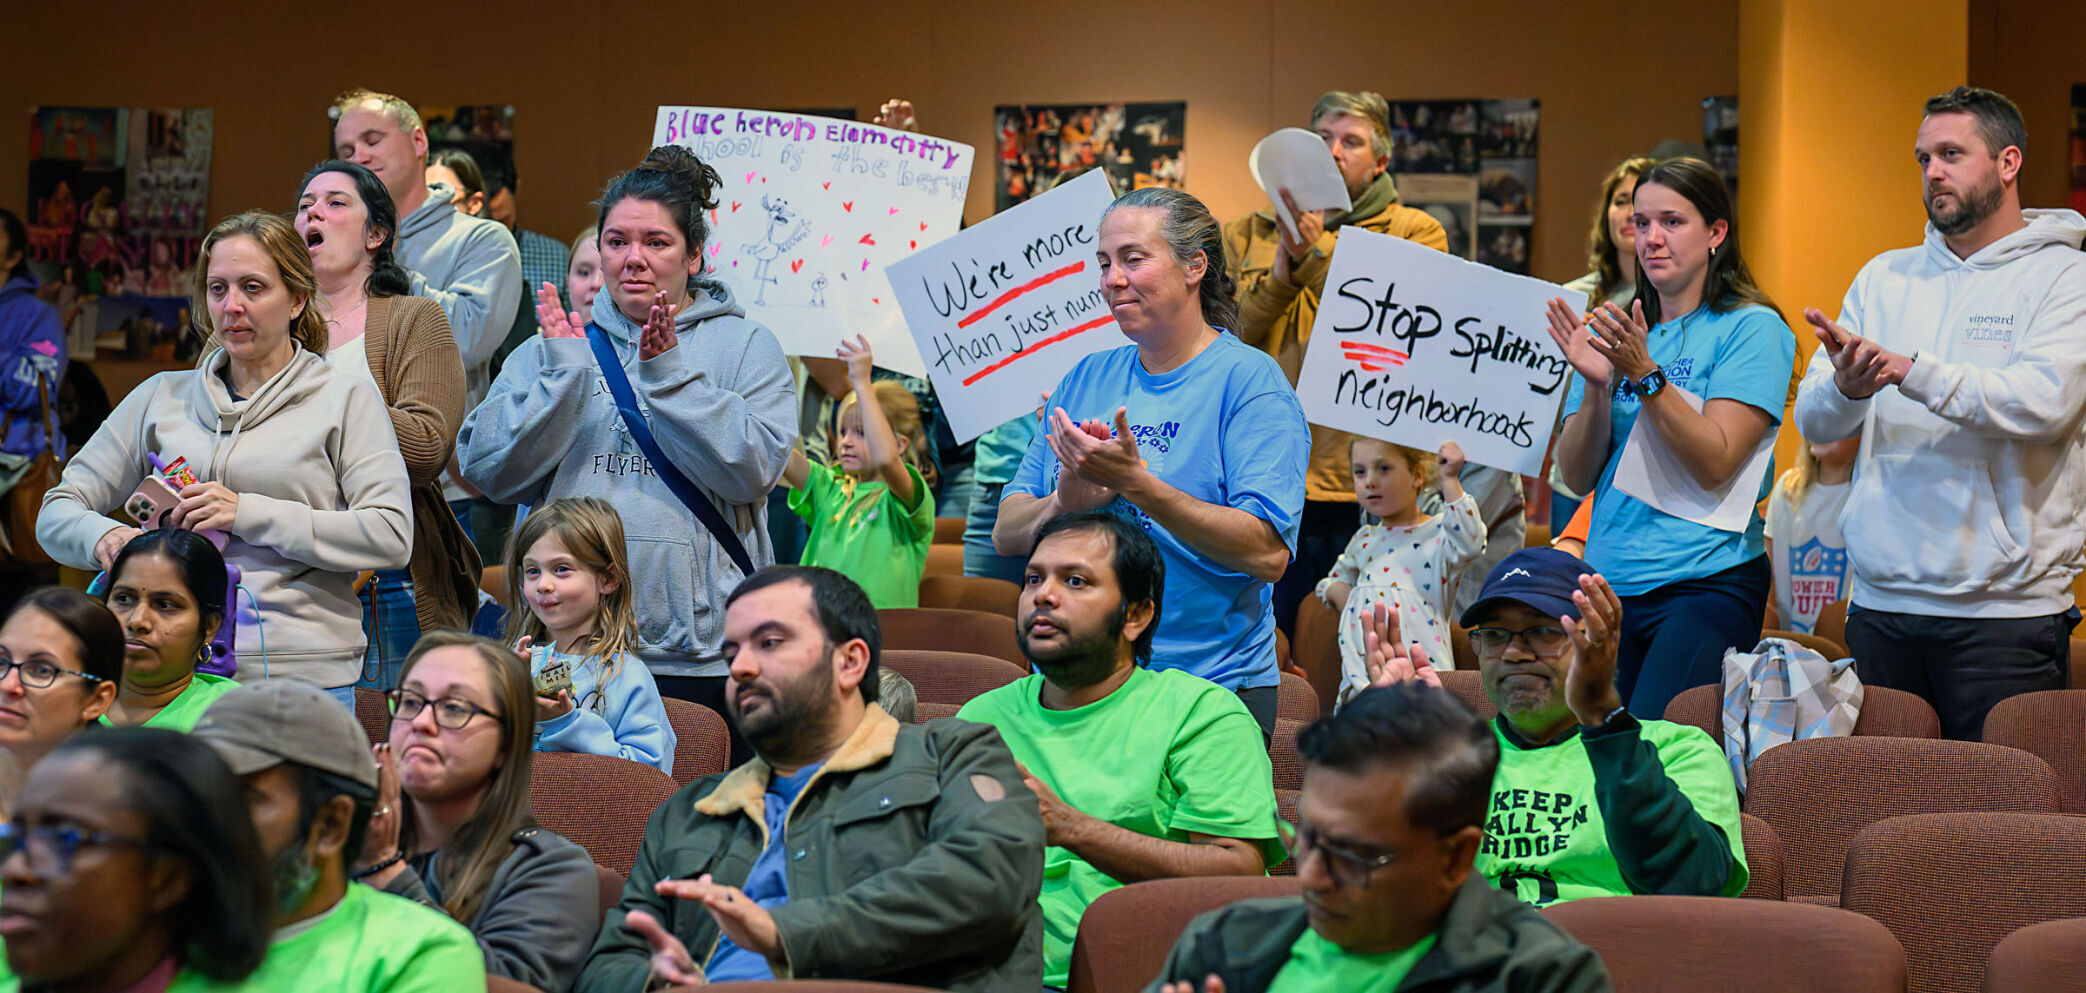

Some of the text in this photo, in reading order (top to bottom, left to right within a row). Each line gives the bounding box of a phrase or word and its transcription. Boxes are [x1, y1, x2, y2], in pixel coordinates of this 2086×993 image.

[666, 109, 725, 143] Blue
[736, 111, 816, 141] heron
[922, 224, 1094, 317] We're more
[1333, 277, 1569, 395] Stop Splitting
[1969, 314, 2014, 326] vineyard
[934, 332, 1002, 374] than
[1005, 304, 1059, 353] just
[1335, 369, 1534, 448] neighborhoods
[546, 673, 567, 685] MIX
[1493, 788, 1573, 814] KEEP
[1484, 804, 1588, 836] ALLYN
[1481, 834, 1570, 859] RIDGE
